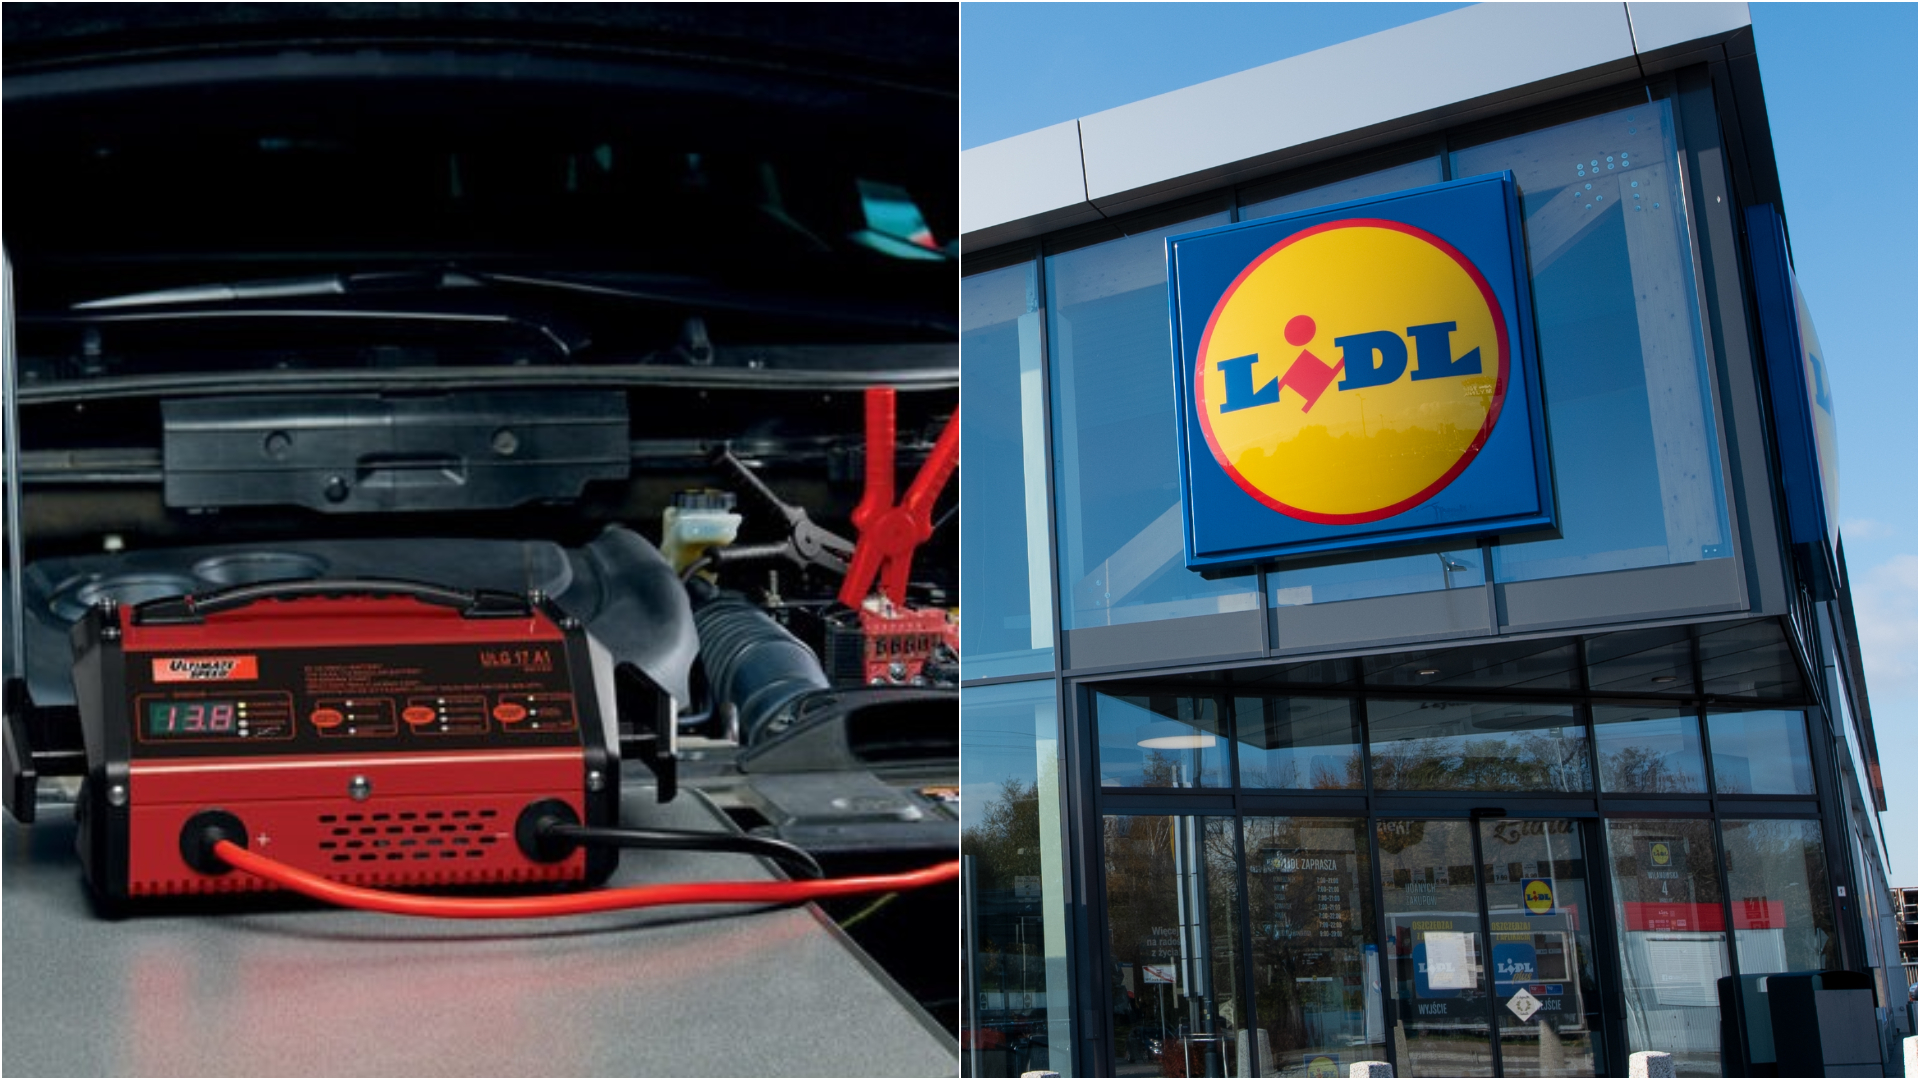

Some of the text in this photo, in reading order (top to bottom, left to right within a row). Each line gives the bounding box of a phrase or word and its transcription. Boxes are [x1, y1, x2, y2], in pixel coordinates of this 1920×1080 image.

[1301, 859, 1337, 871] ZAPRASZA
[1405, 882, 1436, 894] UDANYCH
[1661, 880, 1668, 896] 4
[1151, 926, 1179, 937] Więcej
[1511, 970, 1533, 985] plus
[1418, 1001, 1448, 1015] WYJŚCIE
